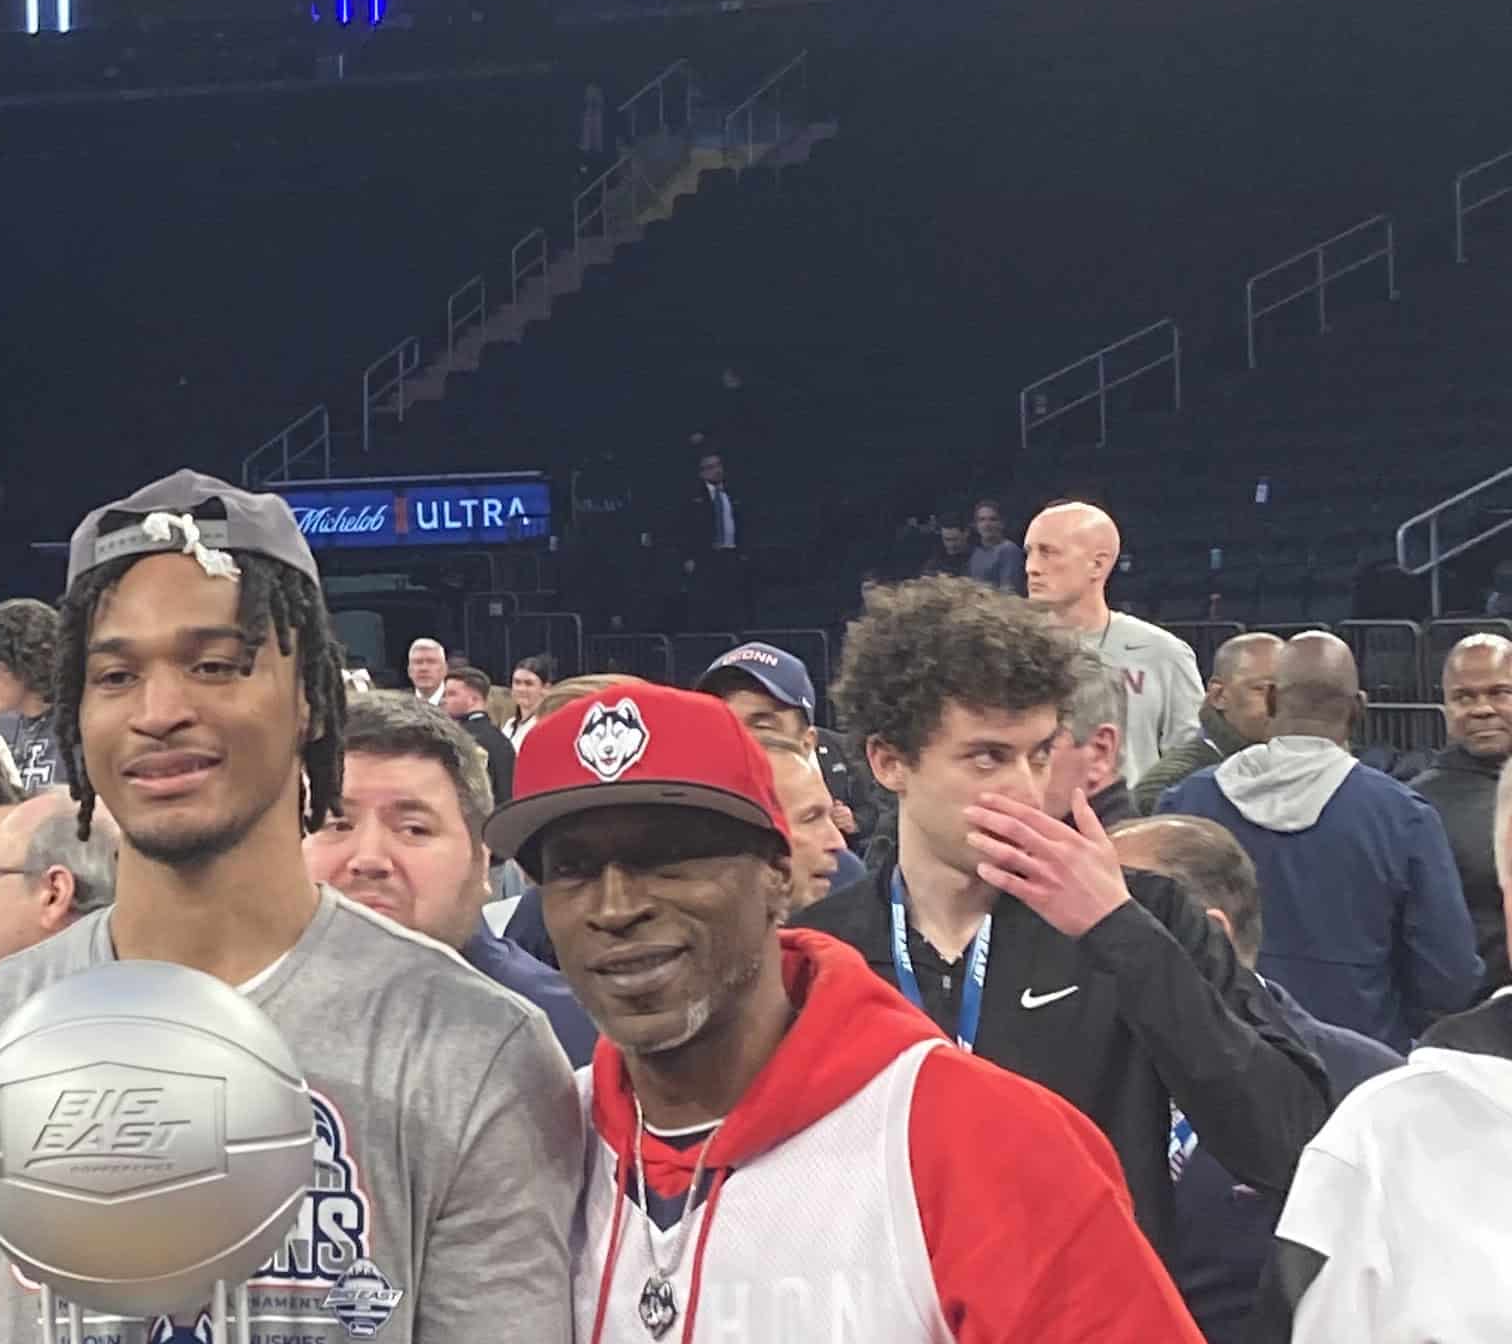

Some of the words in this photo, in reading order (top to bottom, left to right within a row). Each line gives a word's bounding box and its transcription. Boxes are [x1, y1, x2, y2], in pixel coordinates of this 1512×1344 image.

[292, 504, 390, 536] Michelob
[416, 496, 530, 531] ULTRA
[48, 1087, 164, 1121] BIG
[31, 1119, 193, 1152] EAST
